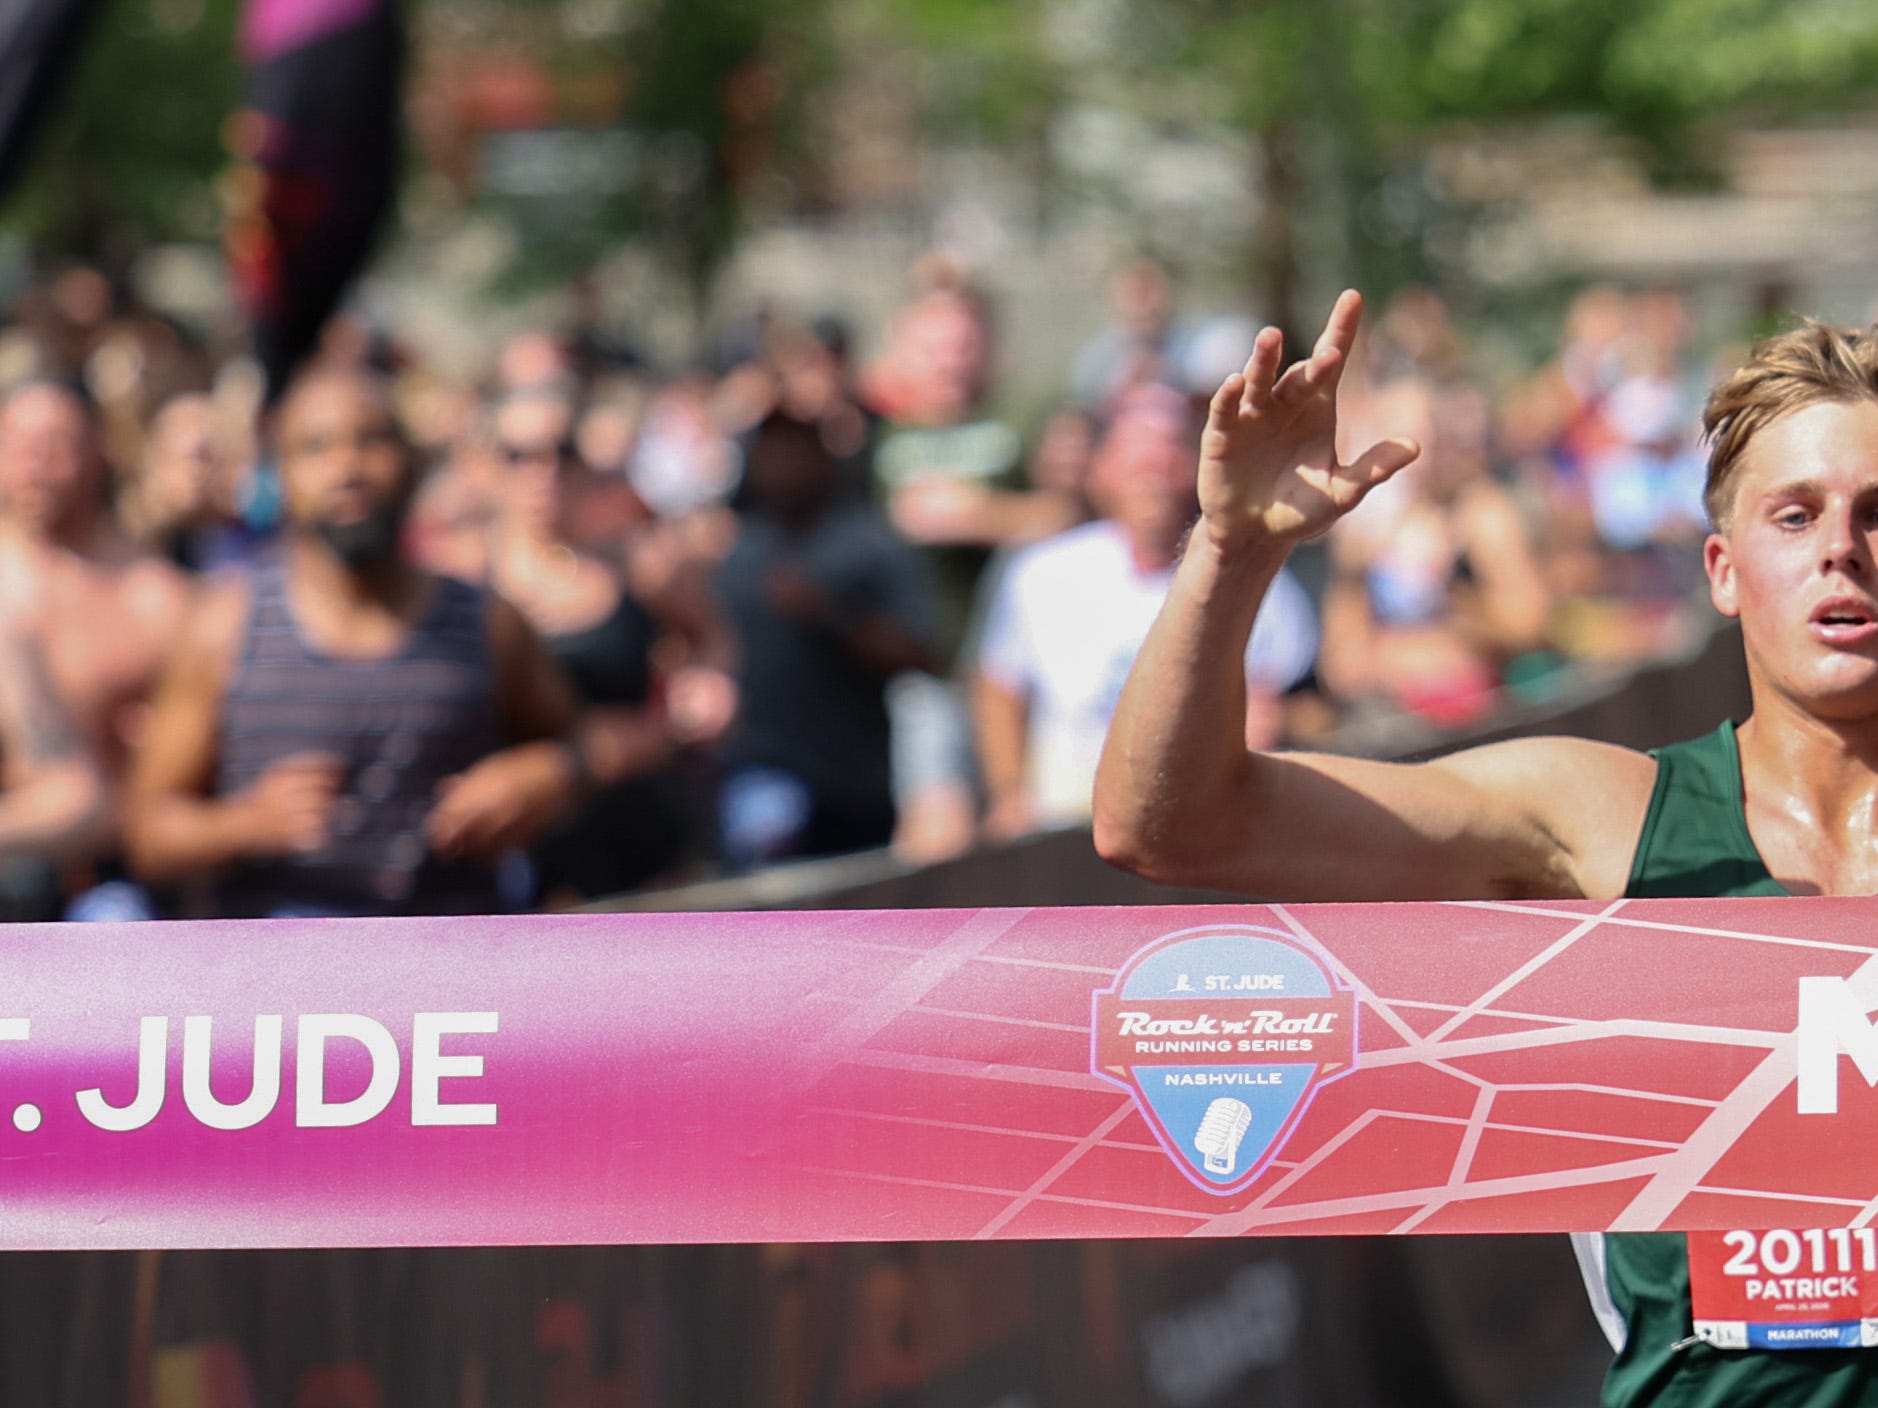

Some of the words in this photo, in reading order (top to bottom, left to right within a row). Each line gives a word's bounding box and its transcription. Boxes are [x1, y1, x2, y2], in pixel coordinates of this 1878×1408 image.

[1204, 975, 1231, 992] ST.
[1233, 974, 1285, 991] JUDE
[1135, 1040, 1232, 1054] RUNNING
[1238, 1039, 1313, 1053] SERIES
[76, 1012, 499, 1132] JUDE
[1165, 1072, 1283, 1086] NASHVILLE
[1722, 1228, 1877, 1276] 20111
[1745, 1277, 1858, 1300] PATRICK
[1767, 1327, 1840, 1342] MARATHON
